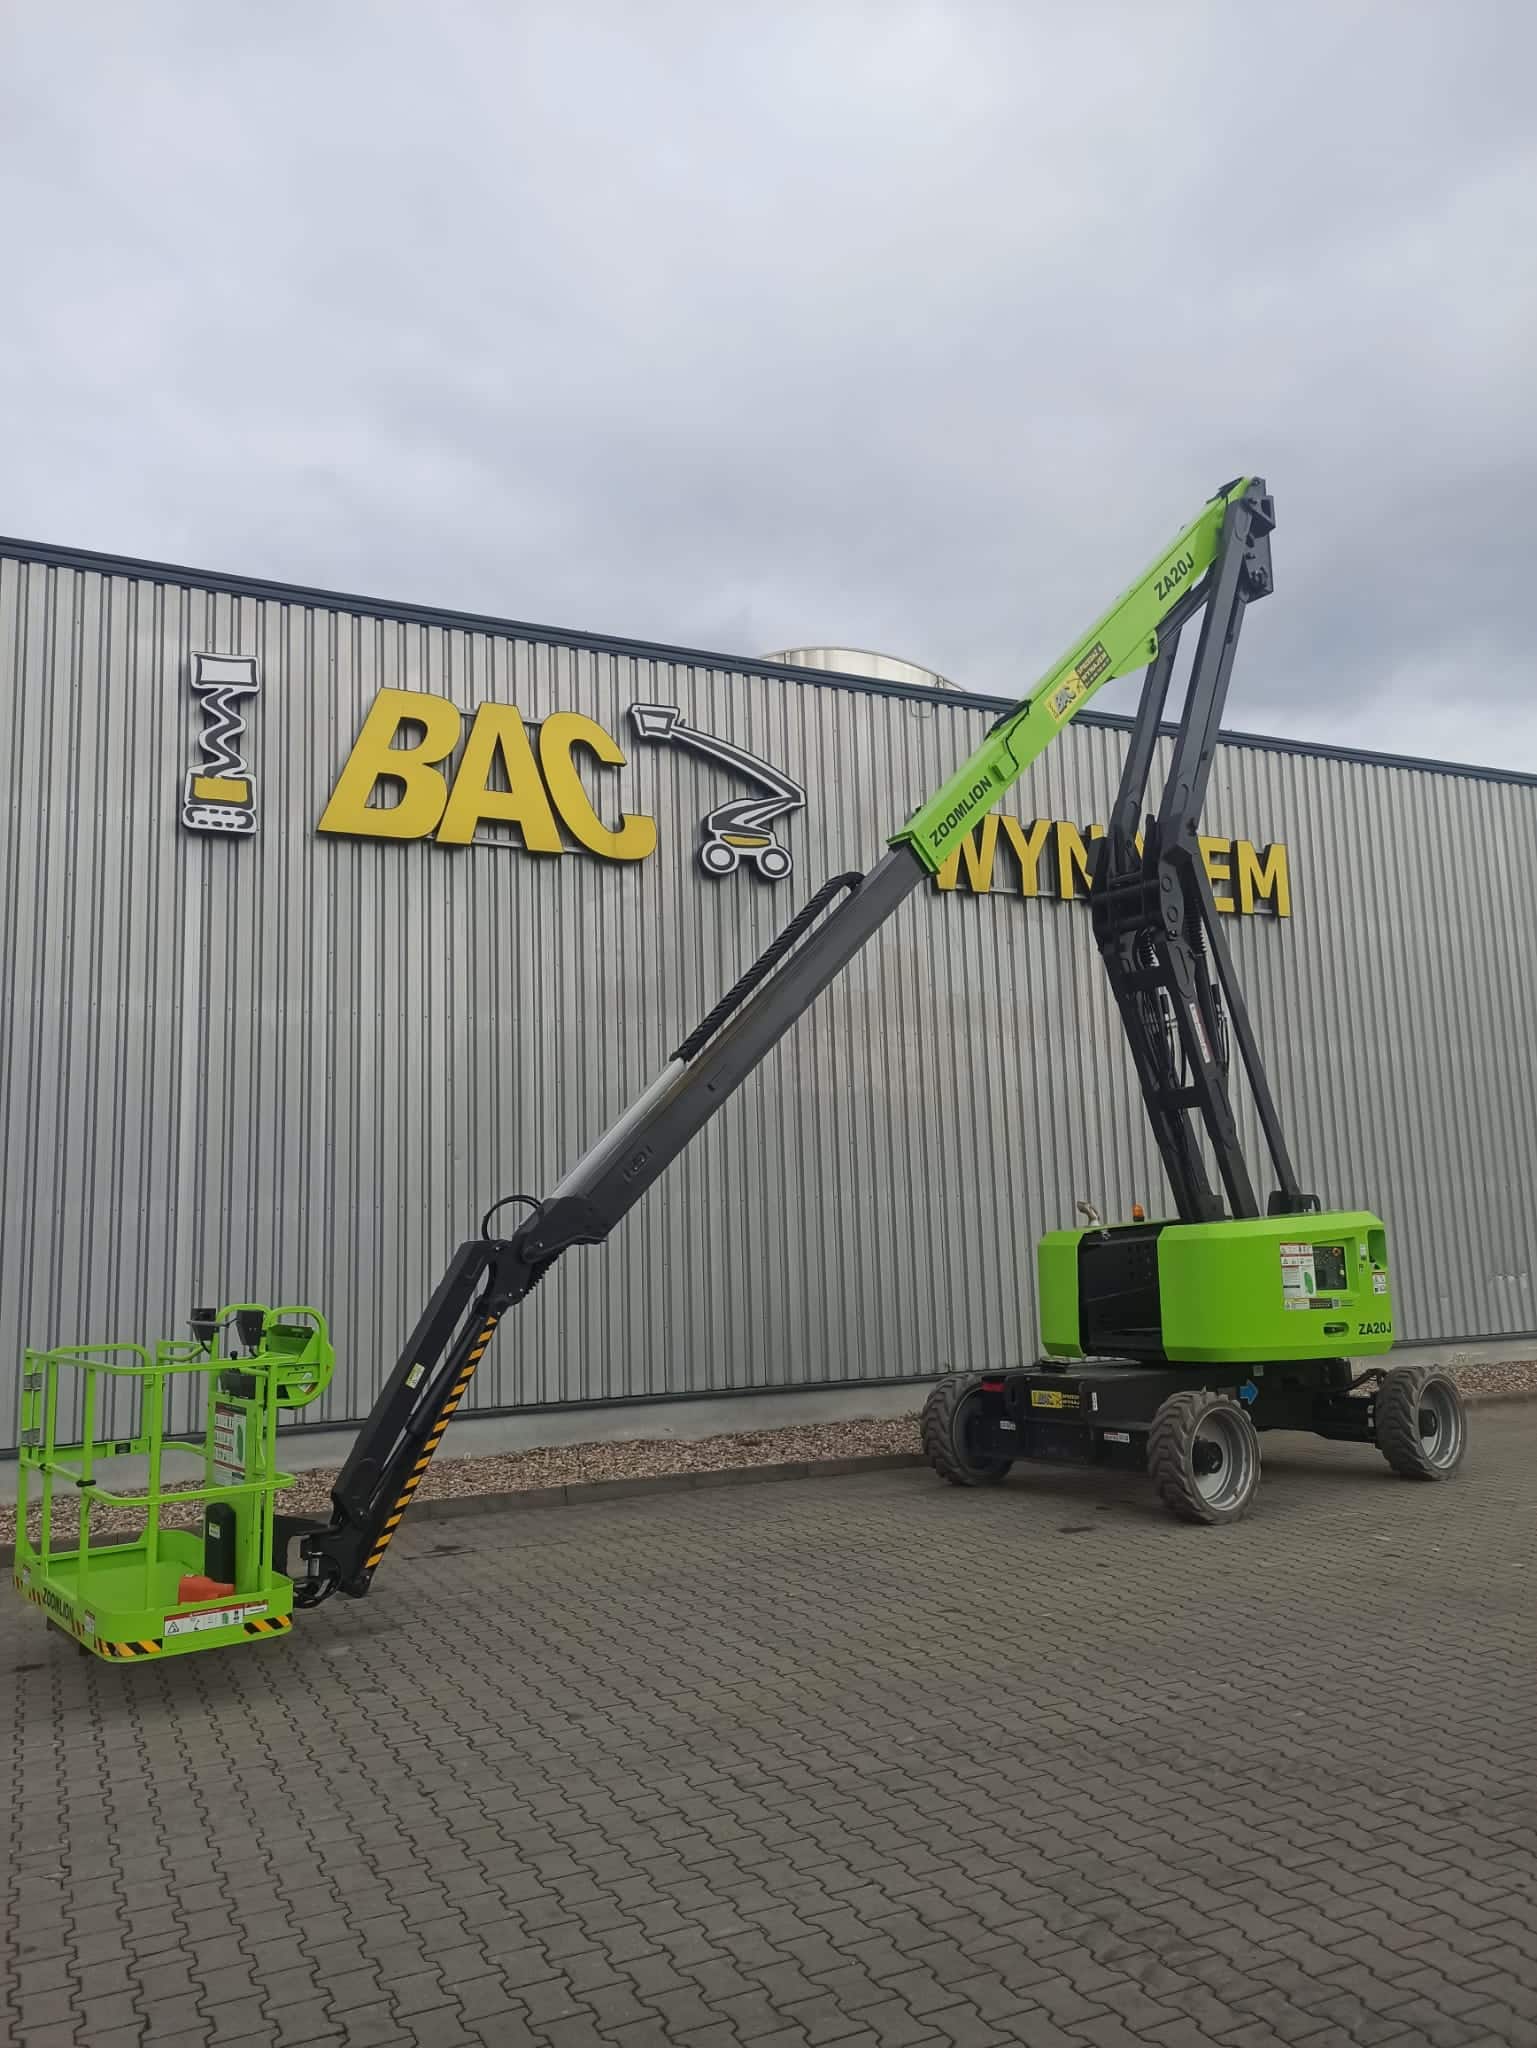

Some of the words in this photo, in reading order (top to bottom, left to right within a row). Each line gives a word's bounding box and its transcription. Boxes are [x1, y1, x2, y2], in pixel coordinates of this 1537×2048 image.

[1154, 552, 1194, 600] ZA20J
[317, 687, 657, 861] BAC
[929, 776, 992, 847] ZOOMLION
[937, 813, 1291, 917] WYNEM
[1359, 1321, 1392, 1335] ZA20J
